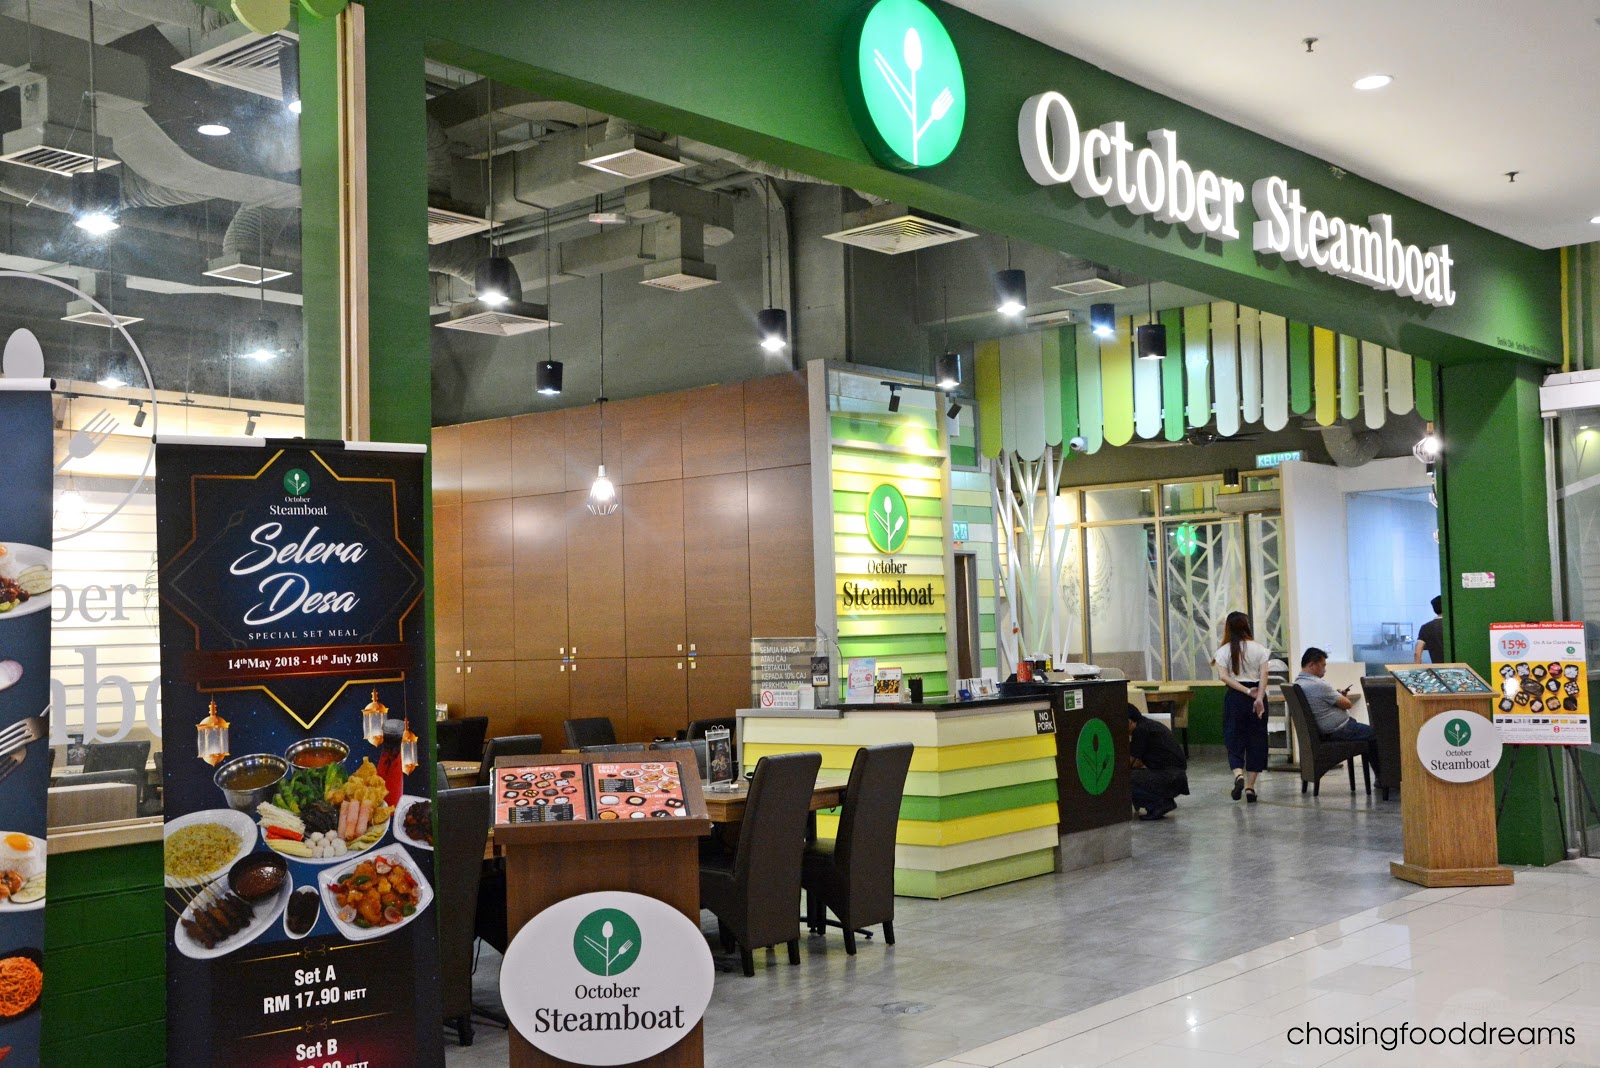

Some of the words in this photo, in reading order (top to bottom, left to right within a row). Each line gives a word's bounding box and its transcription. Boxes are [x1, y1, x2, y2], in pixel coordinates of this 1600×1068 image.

[1018, 91, 1244, 242] October
[1252, 175, 1456, 307] Steamboat
[269, 504, 328, 516] Steamboat
[229, 522, 369, 576] Selera
[867, 559, 907, 574] October
[243, 572, 361, 626] Desa
[842, 580, 935, 607] Steamboat
[248, 631, 298, 640] SPECIAL
[303, 630, 323, 638] SET
[328, 629, 358, 637] MEAL
[1501, 640, 1527, 650] 15%
[274, 656, 300, 668] 2018
[310, 654, 328, 666] 14th
[330, 654, 352, 666] July
[355, 652, 379, 663] 2018
[1038, 712, 1049, 721] NO
[1037, 722, 1054, 731] PORK
[1445, 749, 1472, 757] October
[1430, 758, 1491, 771] Steamboat
[294, 967, 321, 986] Set
[325, 964, 337, 982] A
[574, 982, 641, 999] October
[263, 994, 290, 1015] RM
[294, 986, 340, 1009] 17.90
[344, 988, 368, 1001] NETT
[534, 1003, 685, 1034] Steamboat
[296, 1042, 322, 1061] Set
[326, 1038, 338, 1056] B
